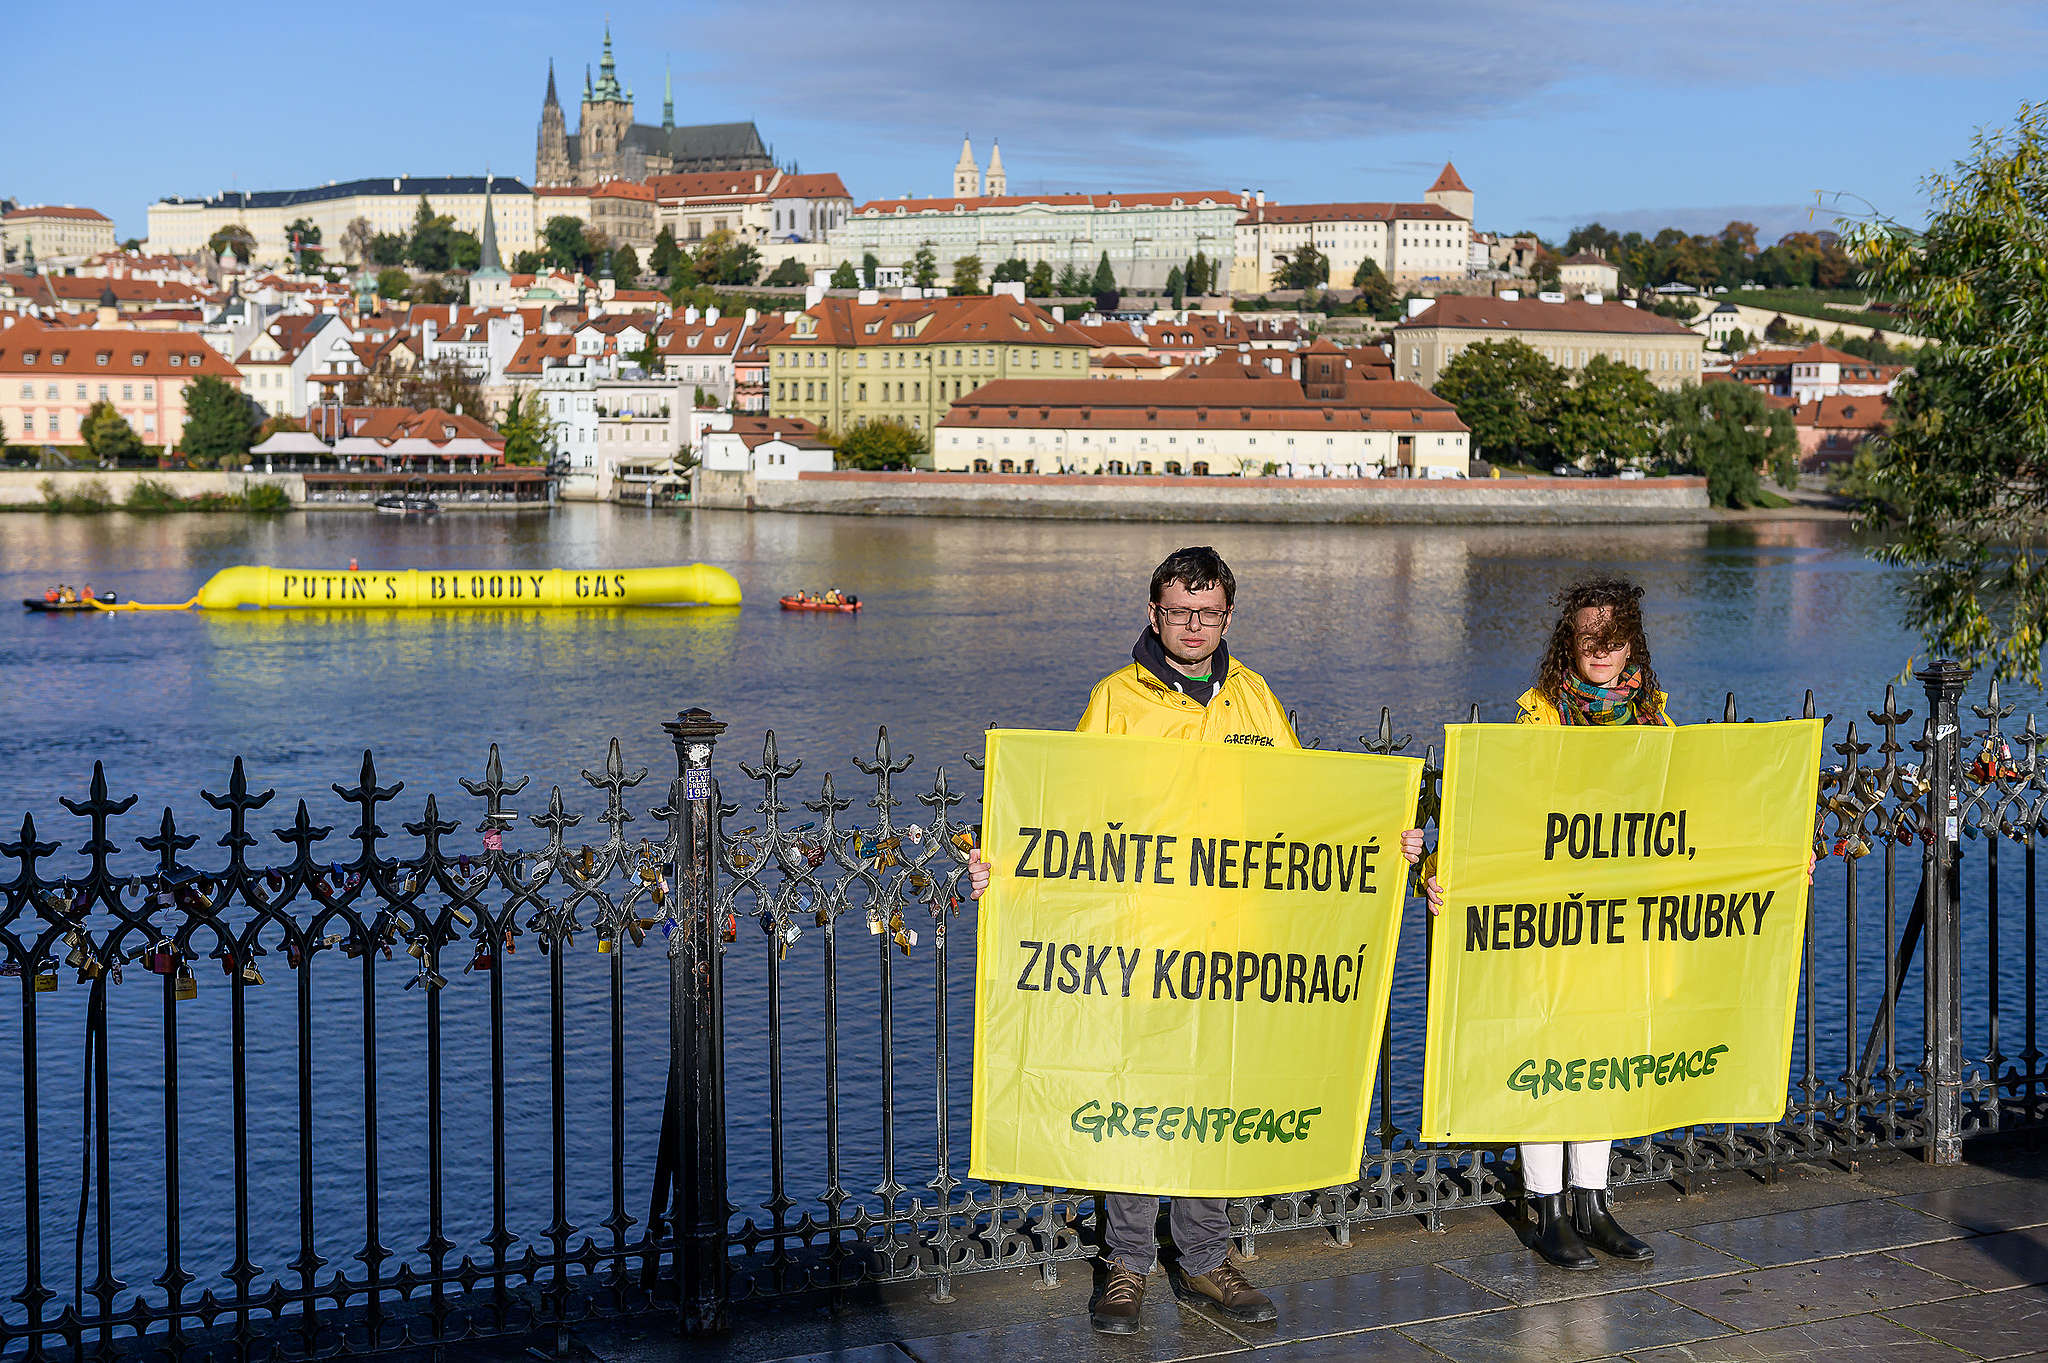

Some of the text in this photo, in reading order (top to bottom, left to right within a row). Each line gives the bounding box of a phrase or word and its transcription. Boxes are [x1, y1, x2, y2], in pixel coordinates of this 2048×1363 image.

[283, 574, 626, 600] PUTIN'S BLOODY GAS
[1014, 821, 1381, 894] ZDAŇTE NEFÉROVÉ
[1543, 809, 1697, 861] POLITICI,
[1465, 890, 1776, 952] NEBUĎTE TRUBKY
[1016, 940, 1368, 1004] ZISKY KORPORACÍ
[1506, 1044, 1730, 1100] GREENPEACE
[1070, 1099, 1322, 1145] GREENPEACE
